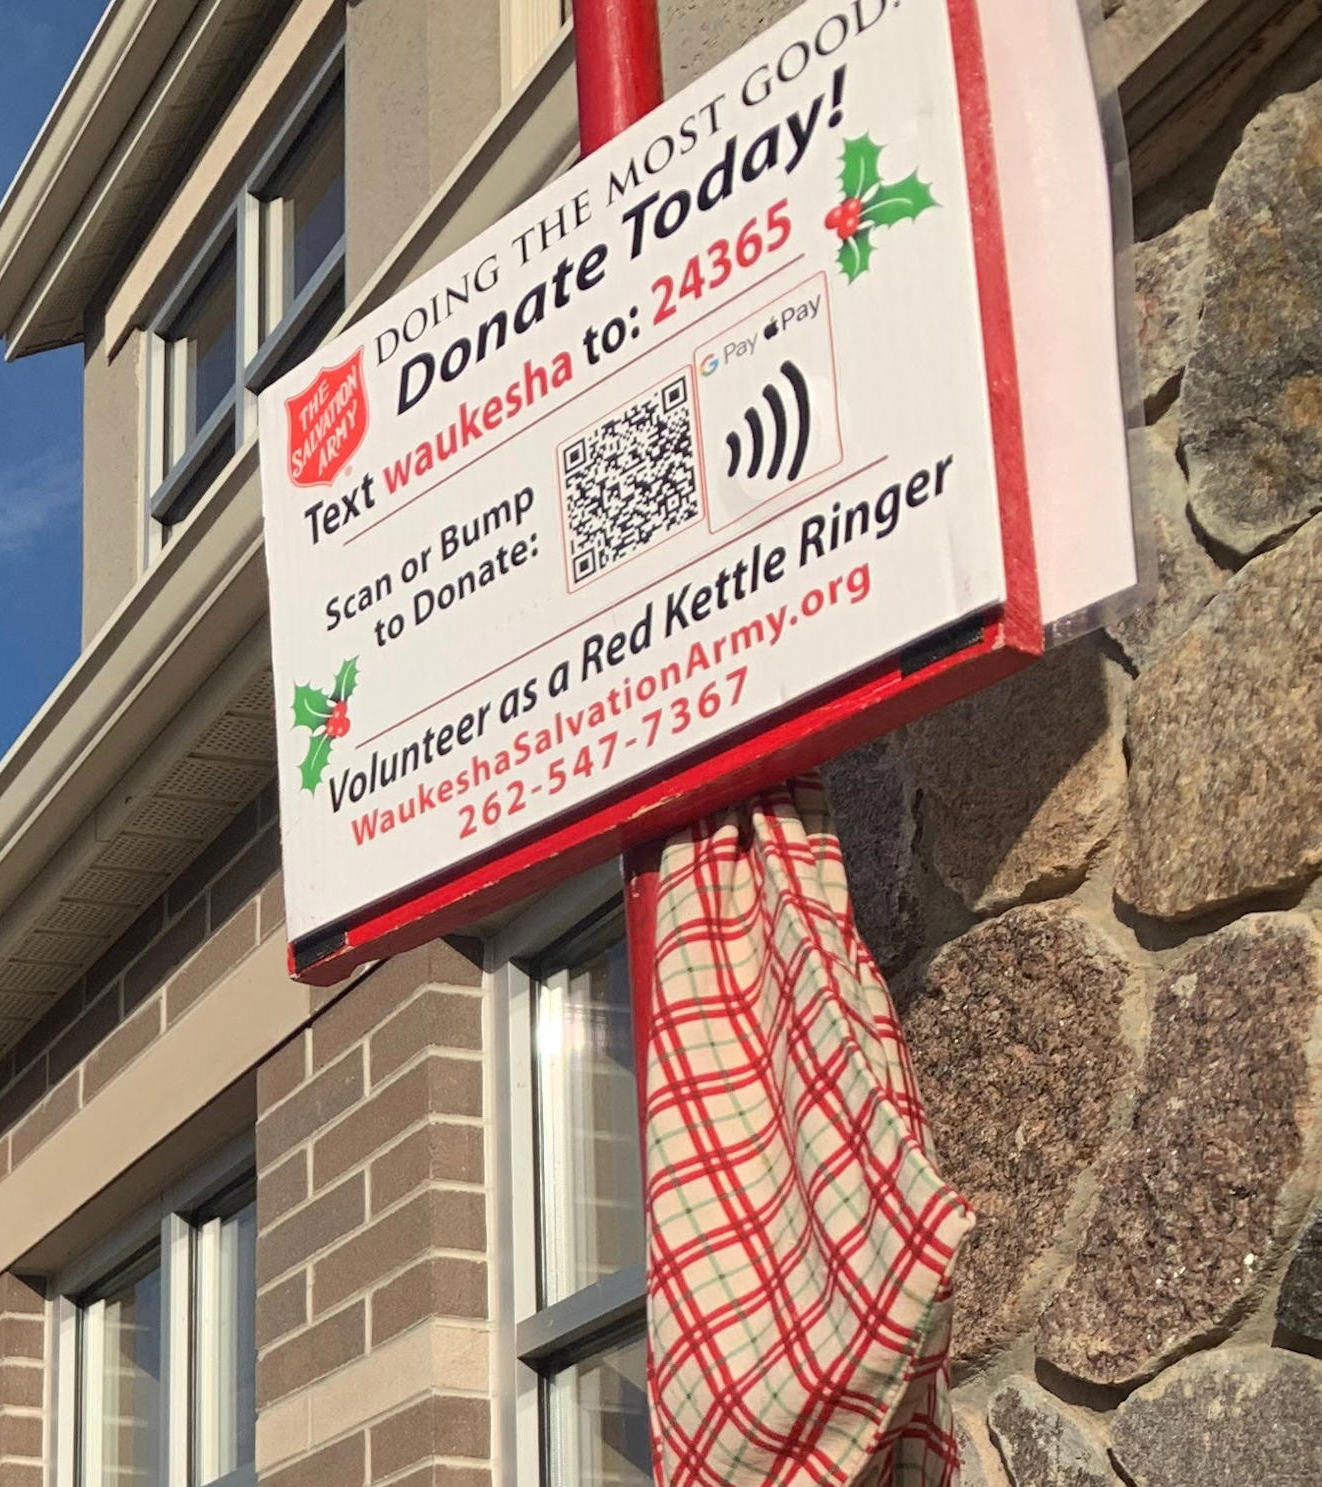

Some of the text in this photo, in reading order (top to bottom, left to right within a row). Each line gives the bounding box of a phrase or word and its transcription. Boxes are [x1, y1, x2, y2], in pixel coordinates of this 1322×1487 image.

[374, 254, 500, 367] DOING
[512, 189, 592, 267] THE
[606, 95, 726, 207] MOST
[396, 63, 847, 416] Donate Today!
[299, 378, 330, 432] THE
[304, 198, 792, 545] Text waukesha to: 24365
[723, 333, 758, 364] Pay
[781, 294, 821, 331] Pay
[291, 364, 358, 479] SALVATION
[318, 398, 357, 477] ARMY
[326, 485, 535, 632] Scan or Bump
[327, 453, 955, 814] Volunteer as a Red Kettle Ringer
[374, 532, 540, 647] to Donate:
[350, 561, 872, 847] WaukeshaSalvationArmy.org
[457, 664, 749, 841] 262-547-7367
